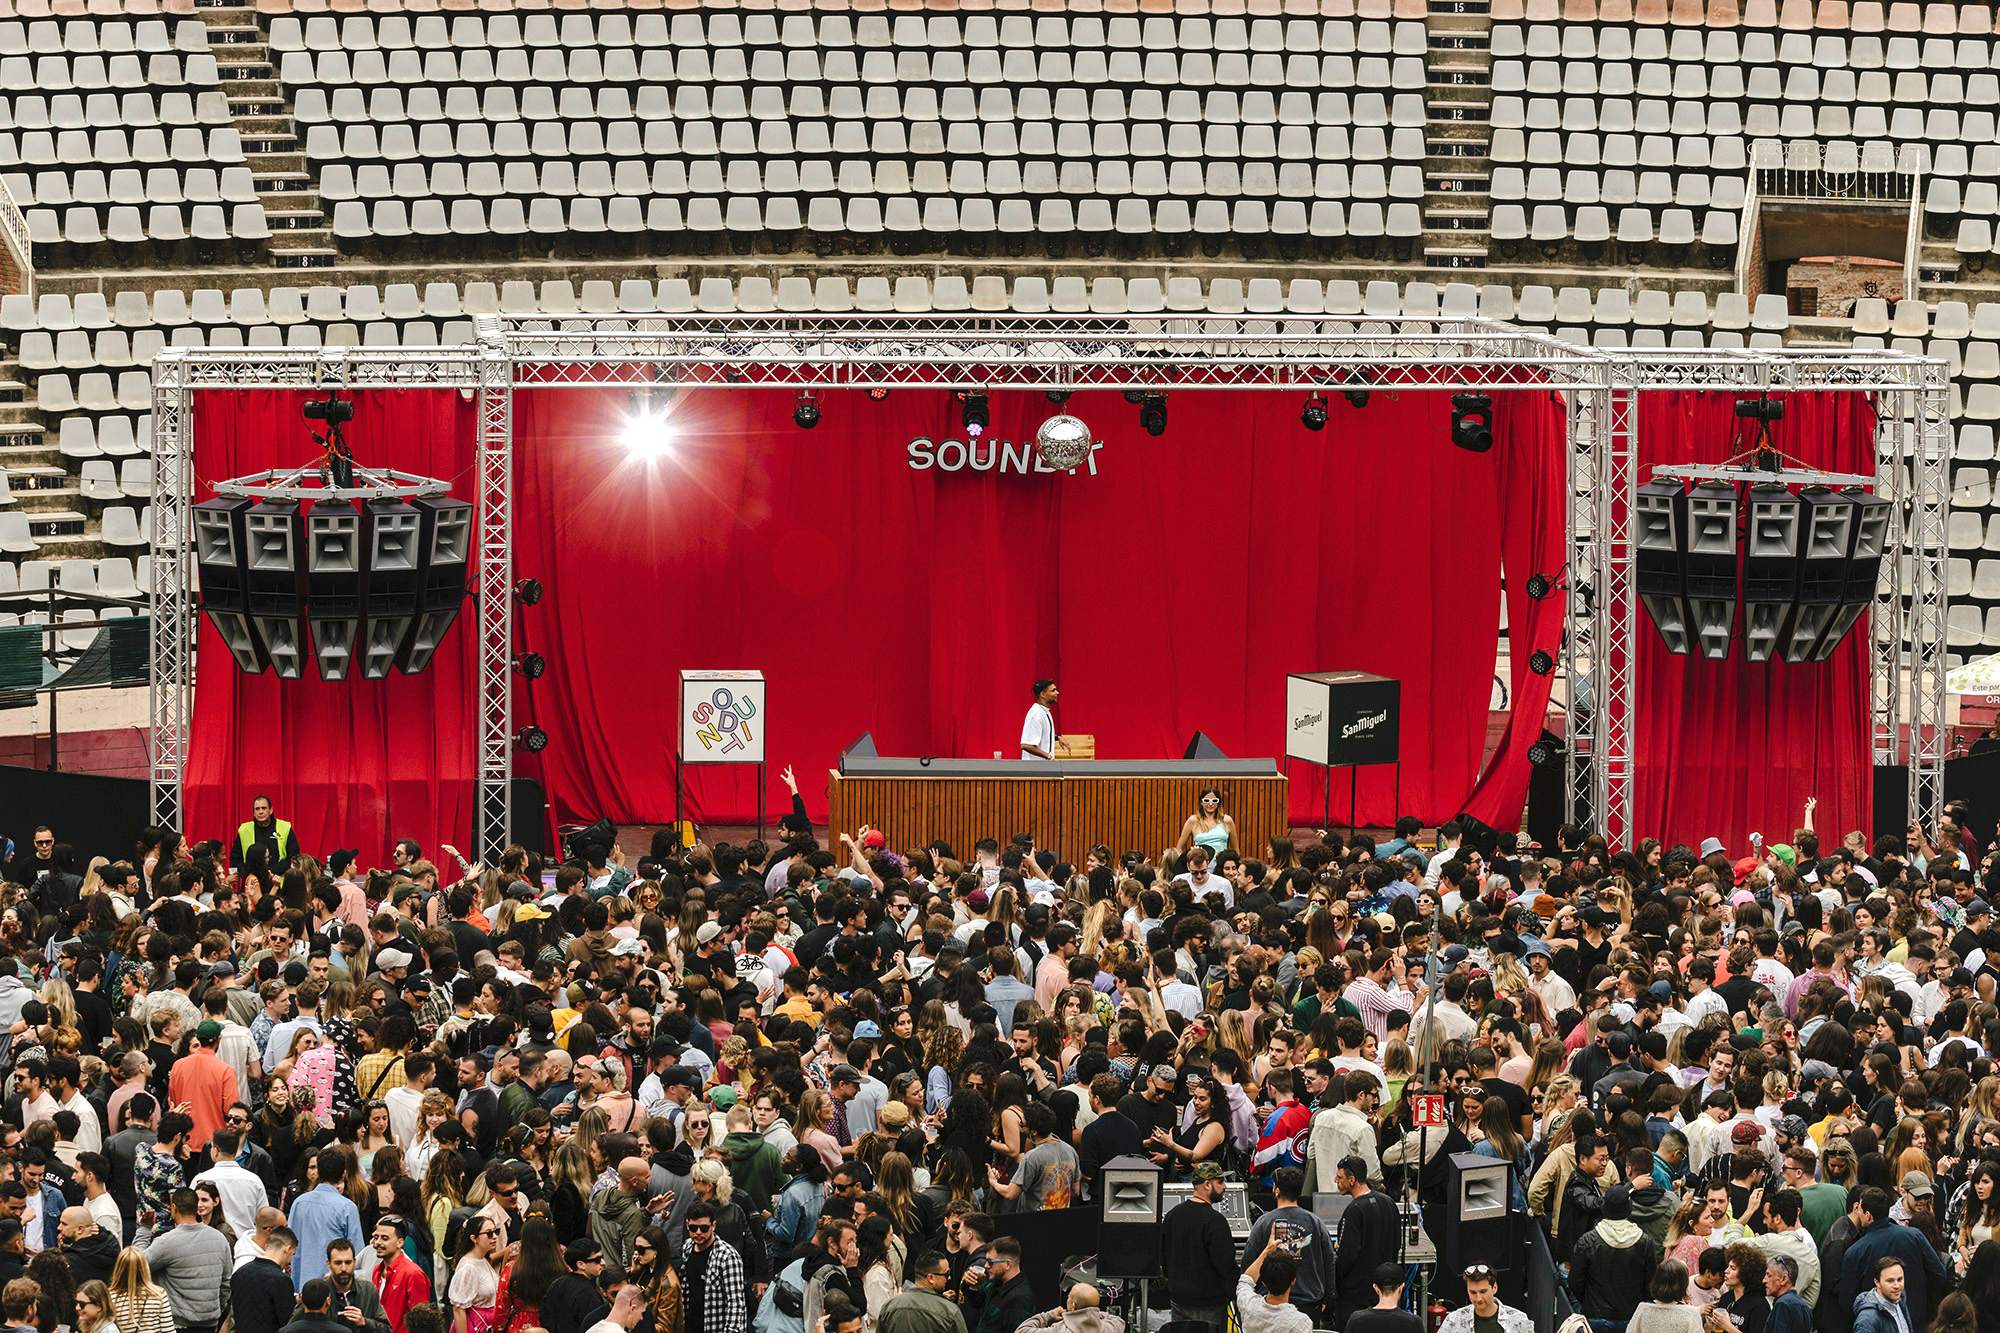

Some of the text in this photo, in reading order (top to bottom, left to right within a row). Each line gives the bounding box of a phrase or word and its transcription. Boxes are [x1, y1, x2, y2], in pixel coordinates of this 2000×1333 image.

[1454, 2, 1465, 13] 15
[224, 32, 234, 43] 14
[1453, 38, 1464, 49] 14
[237, 68, 248, 79] 13
[1452, 73, 1463, 84] 13
[249, 104, 259, 115] 12
[1452, 109, 1463, 120] 12
[261, 141, 272, 152] 11
[1452, 145, 1463, 156] 11
[273, 180, 284, 191] 10
[1451, 180, 1462, 192] 10
[289, 217, 296, 228] 9
[1452, 218, 1459, 229] 9
[302, 255, 308, 267] 8
[1452, 256, 1459, 267] 8
[907, 438, 1104, 476] SOUNT
[50, 522, 57, 534] 2
